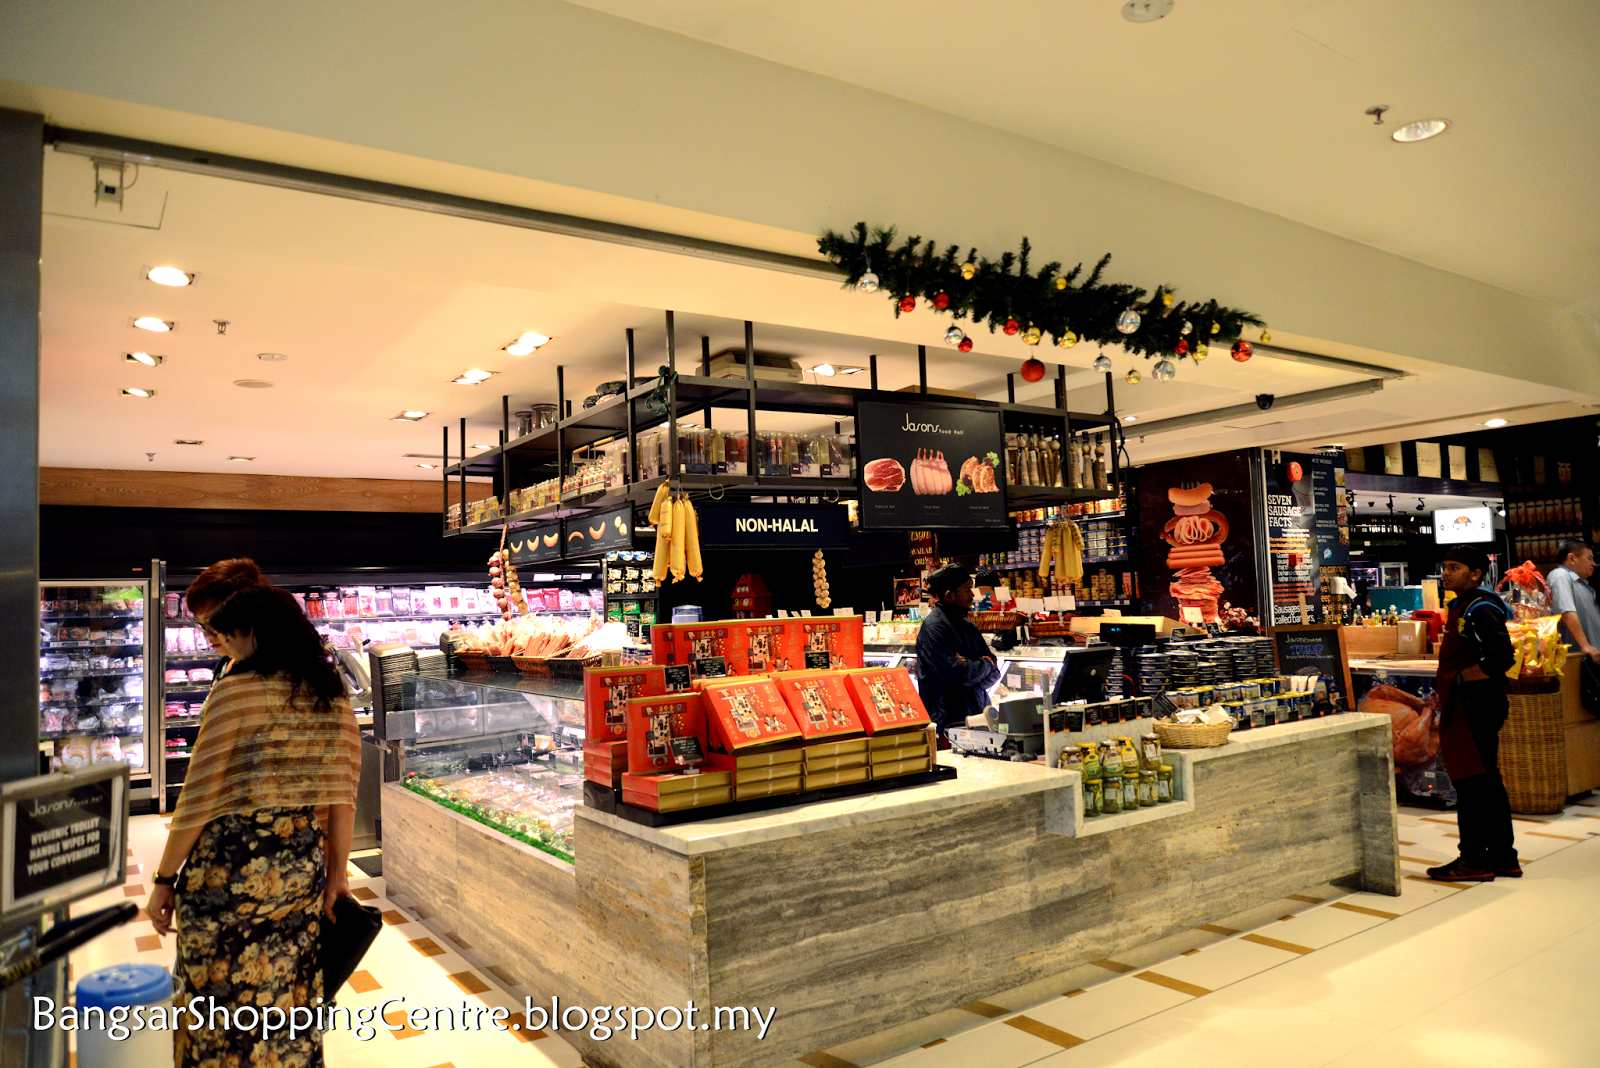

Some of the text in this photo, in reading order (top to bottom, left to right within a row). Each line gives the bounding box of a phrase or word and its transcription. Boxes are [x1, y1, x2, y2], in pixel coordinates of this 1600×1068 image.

[901, 412, 940, 433] Jasons
[1267, 494, 1292, 506] SEVEN
[1268, 506, 1302, 517] SAUSAGE
[735, 518, 819, 533] NON-HALAL
[1269, 516, 1293, 527] FACTS
[1273, 604, 1315, 616] Sausages ere
[1274, 614, 1292, 625] called
[1289, 643, 1324, 655] TULIP
[29, 798, 75, 818] Jasons
[31, 816, 101, 846] HYGIENIC TROLLEY
[29, 830, 101, 861] HANDLE WIPES FOR
[26, 843, 101, 877] YOUR CONVENIENCE
